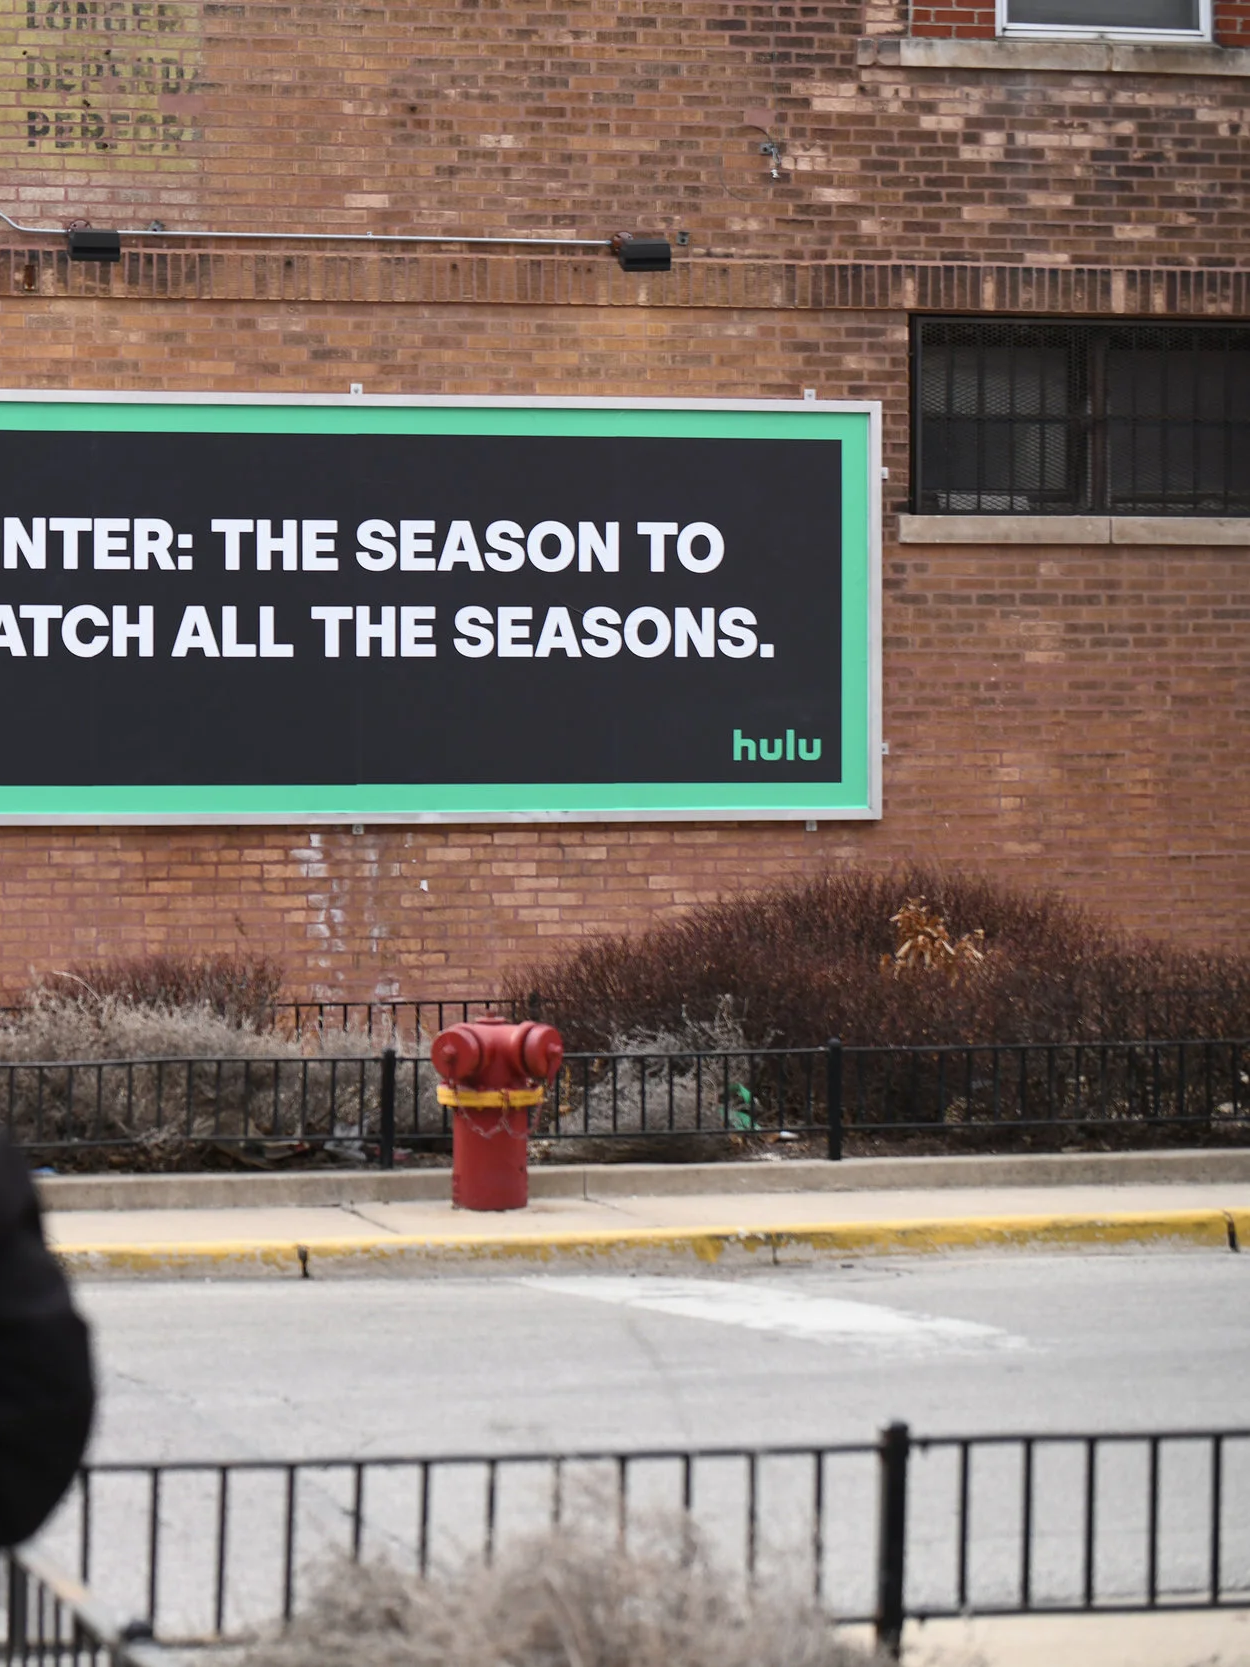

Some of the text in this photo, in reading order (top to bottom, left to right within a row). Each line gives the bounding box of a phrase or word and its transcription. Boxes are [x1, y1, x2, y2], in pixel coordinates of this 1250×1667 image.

[210, 518, 339, 571] THE
[355, 518, 620, 573] SEASON
[636, 521, 725, 574] TO
[171, 605, 294, 658] ALL
[310, 605, 437, 658] THE
[453, 605, 775, 659] SEASONS.
[733, 728, 822, 761] hulu
